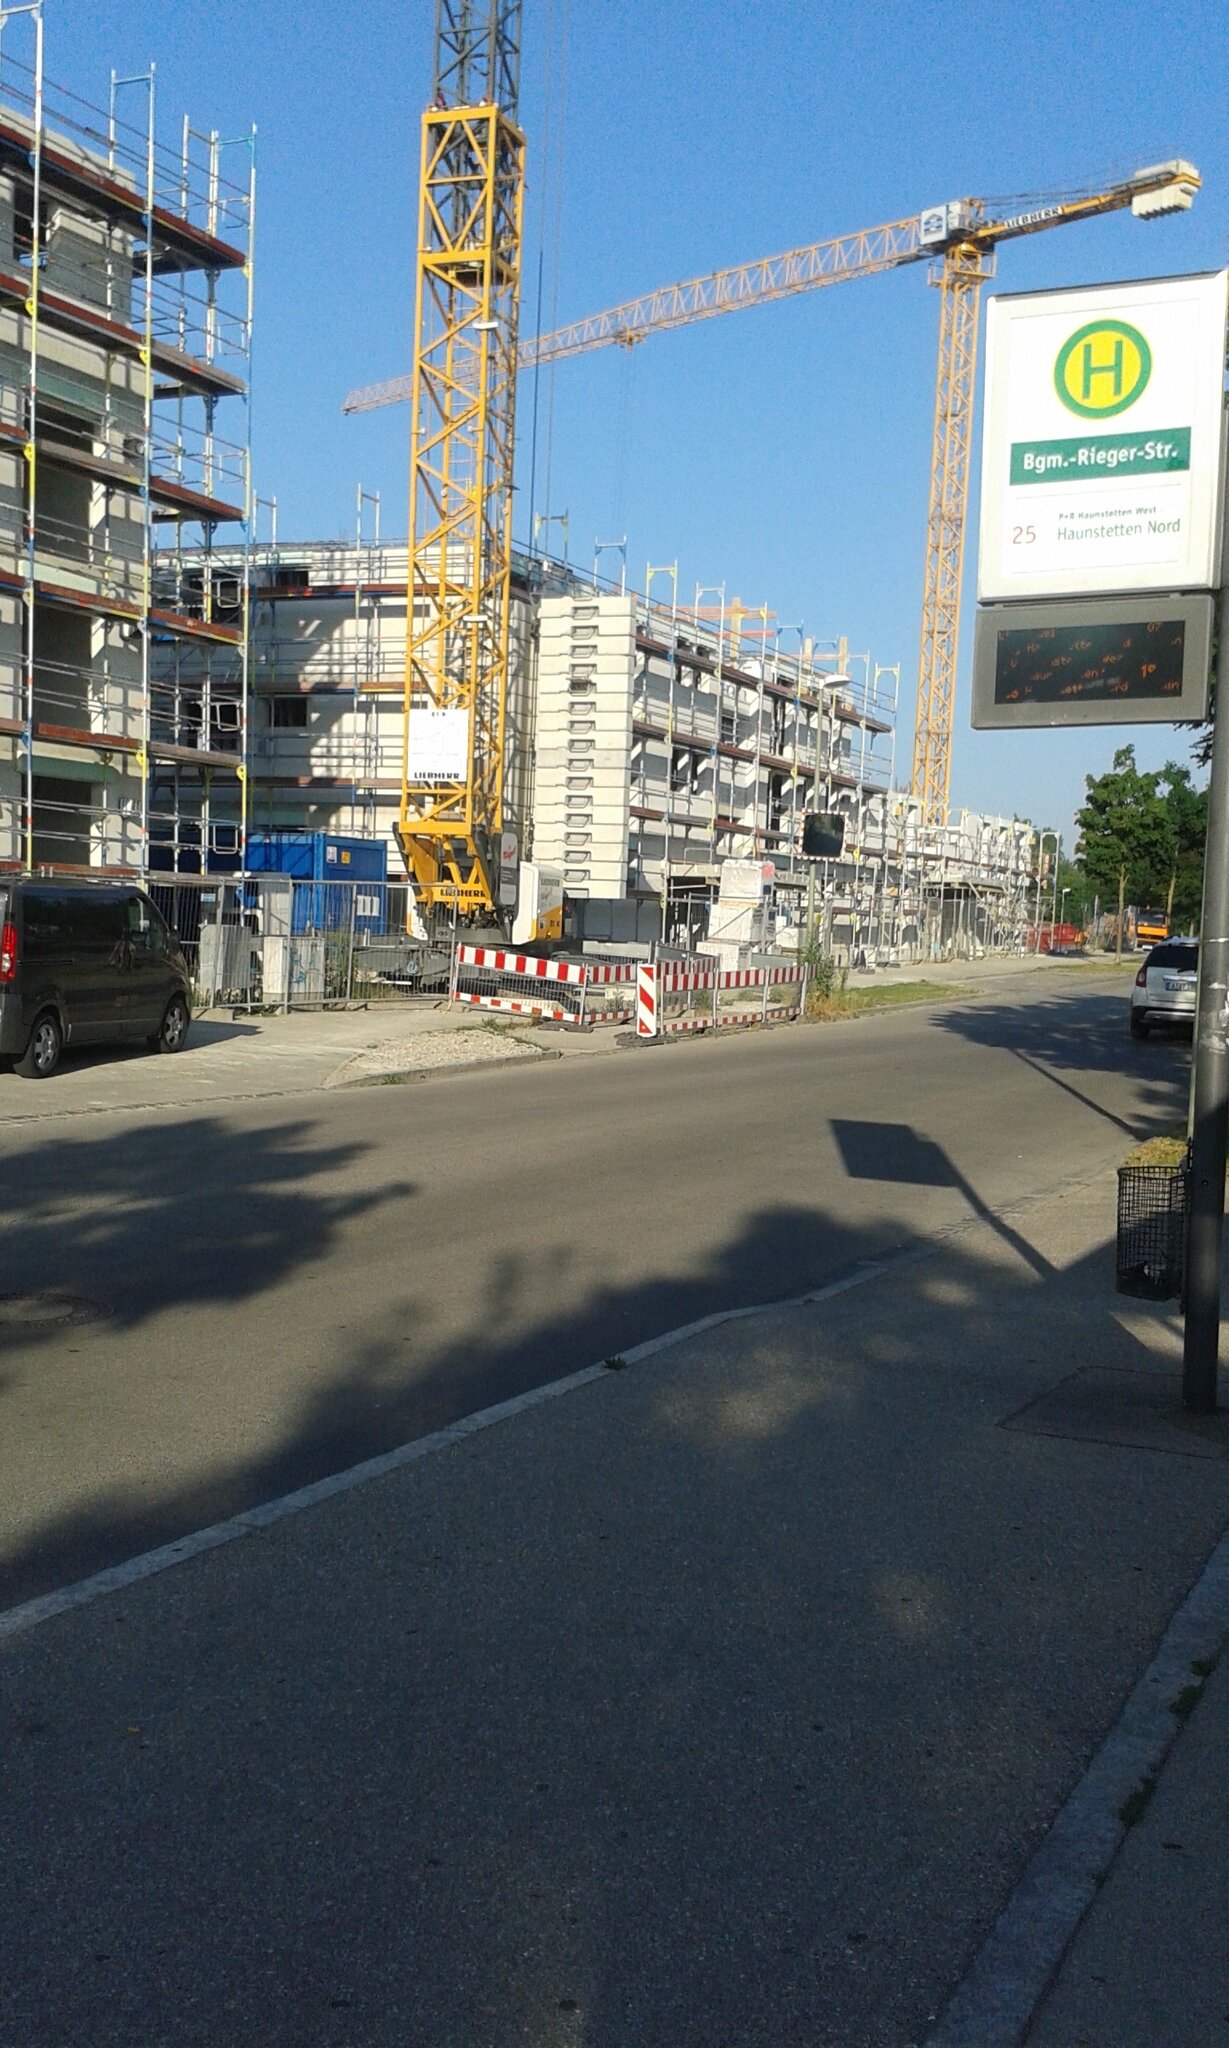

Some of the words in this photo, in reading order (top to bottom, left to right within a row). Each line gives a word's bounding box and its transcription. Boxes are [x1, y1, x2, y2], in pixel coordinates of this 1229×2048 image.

[1082, 340, 1122, 399] H
[1022, 441, 1179, 474] Bgm.-Rieger-Str.
[1135, 505, 1157, 516] West
[1012, 525, 1037, 545] 25
[1057, 523, 1143, 542] Haunstetten
[1147, 518, 1182, 535] Nord
[414, 771, 461, 780] LIEBHERR
